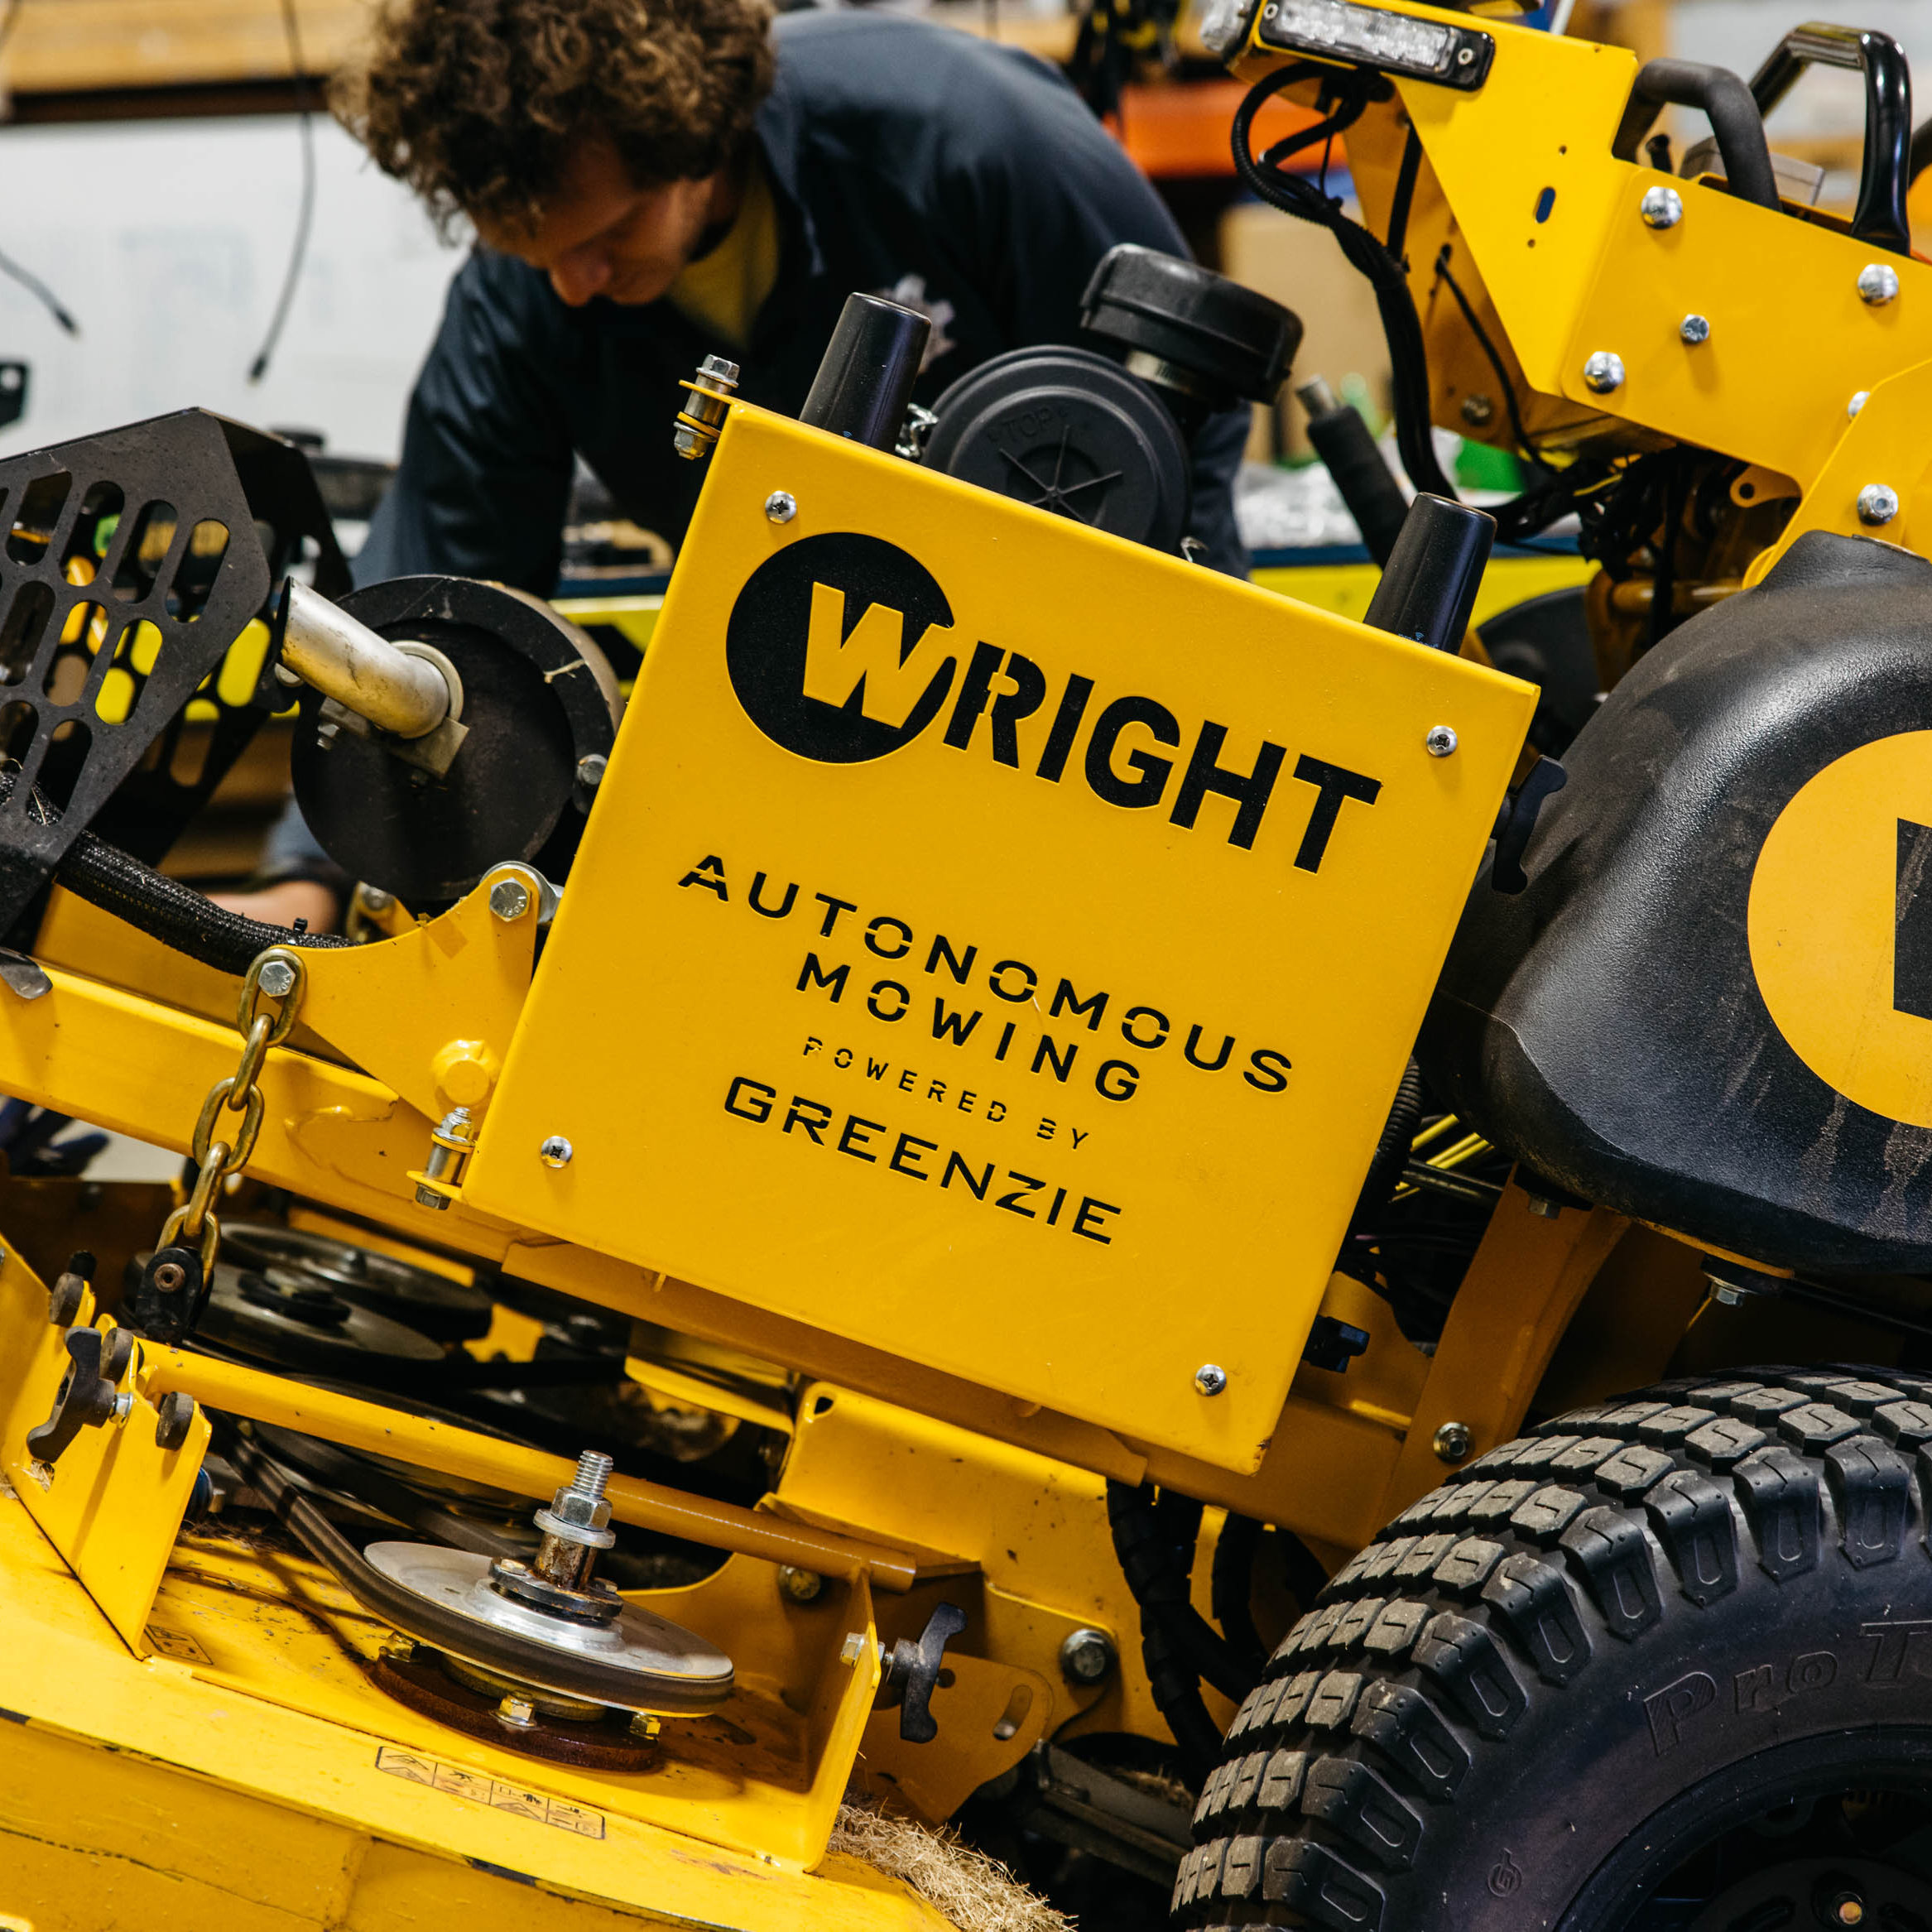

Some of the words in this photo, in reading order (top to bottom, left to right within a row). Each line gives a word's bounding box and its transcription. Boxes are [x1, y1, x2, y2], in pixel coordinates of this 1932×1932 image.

[801, 580, 1383, 875] WRIGHT
[677, 854, 1292, 1093] AUTONOMOUS
[795, 952, 1141, 1102] MOWING
[724, 1076, 1122, 1245] GREENZIE
[803, 1036, 1007, 1122] POWERED
[1036, 1117, 1089, 1150] BY
